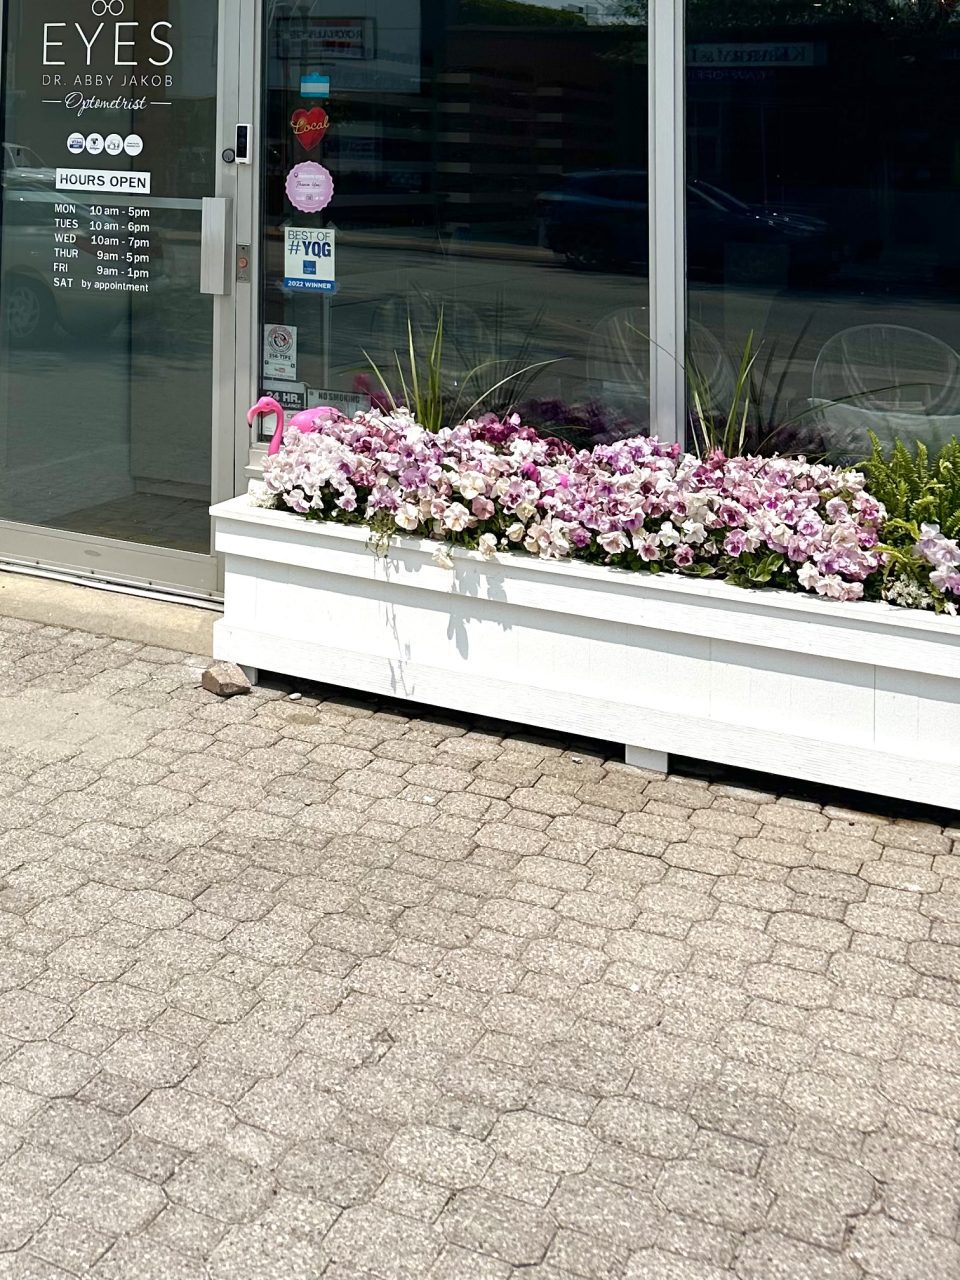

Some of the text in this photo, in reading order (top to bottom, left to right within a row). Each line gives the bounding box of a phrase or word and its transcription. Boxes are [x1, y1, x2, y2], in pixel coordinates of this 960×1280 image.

[42, 21, 173, 66] EYES
[42, 74, 173, 87] DR. ABBY JAKOB
[64, 91, 148, 117] Optometrist
[291, 114, 329, 134] Local
[60, 173, 146, 189] HOURS OPEN
[54, 204, 76, 214] MON
[128, 206, 150, 218] 5pm
[54, 218, 79, 229] TUES
[127, 221, 150, 233] 6pm
[54, 233, 77, 243] WED
[91, 235, 119, 246] 10am
[128, 237, 150, 248] 7pm
[288, 230, 331, 241] BEST OF
[54, 248, 79, 258] THUR
[96, 250, 119, 261] 9am
[288, 240, 331, 258] #YQG
[53, 263, 68, 273] FRI
[96, 265, 118, 276] 9am
[127, 267, 149, 279] 1pm
[53, 277, 149, 292] SAT by appointment
[305, 281, 332, 289] WINNER
[282, 392, 301, 403] HR.
